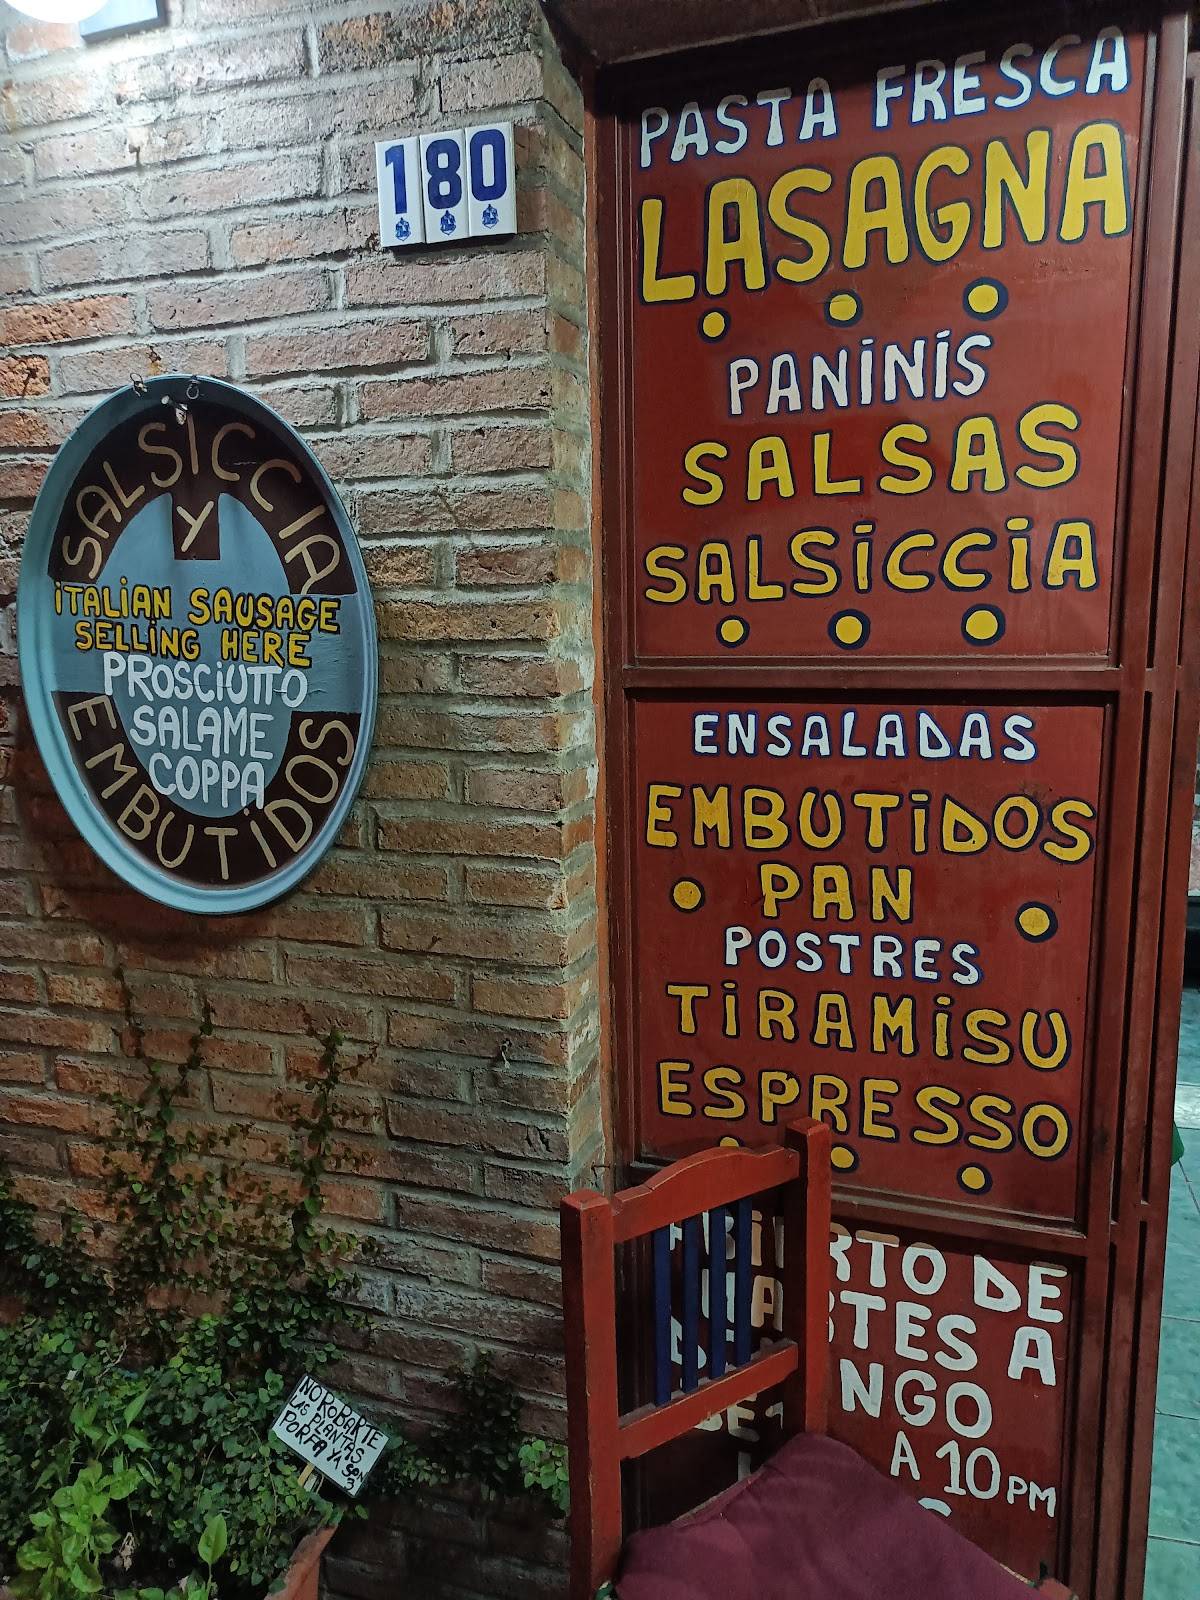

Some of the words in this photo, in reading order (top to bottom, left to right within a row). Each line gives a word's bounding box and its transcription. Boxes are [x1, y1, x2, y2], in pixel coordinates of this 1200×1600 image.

[640, 76, 838, 168] PASTA
[875, 26, 1129, 128] FRESCA
[384, 128, 507, 215] 180
[638, 121, 1131, 304] LASAGNA
[681, 403, 1080, 507] SALSAS
[63, 413, 340, 596] SALSICCIA
[177, 500, 214, 552] Y
[188, 587, 341, 632] SAUSAGE
[220, 629, 312, 667] HERE
[130, 705, 274, 760] SALAME
[693, 710, 1037, 762] ENSALADAS
[149, 752, 265, 809] COPPA
[758, 863, 912, 922] PAN
[725, 926, 982, 985] POSTRES
[659, 1061, 1070, 1159] ESPRESSO
[974, 1254, 1067, 1323] DE
[1007, 1326, 1056, 1386] A
[279, 1410, 328, 1458] PORFA
[327, 1448, 341, 1470] YA
[288, 1395, 310, 1416] LAS
[308, 1412, 364, 1463] PLANTAS
[299, 1379, 322, 1402] NO
[317, 1391, 383, 1450] ROBARTE
[890, 1431, 921, 1481] A
